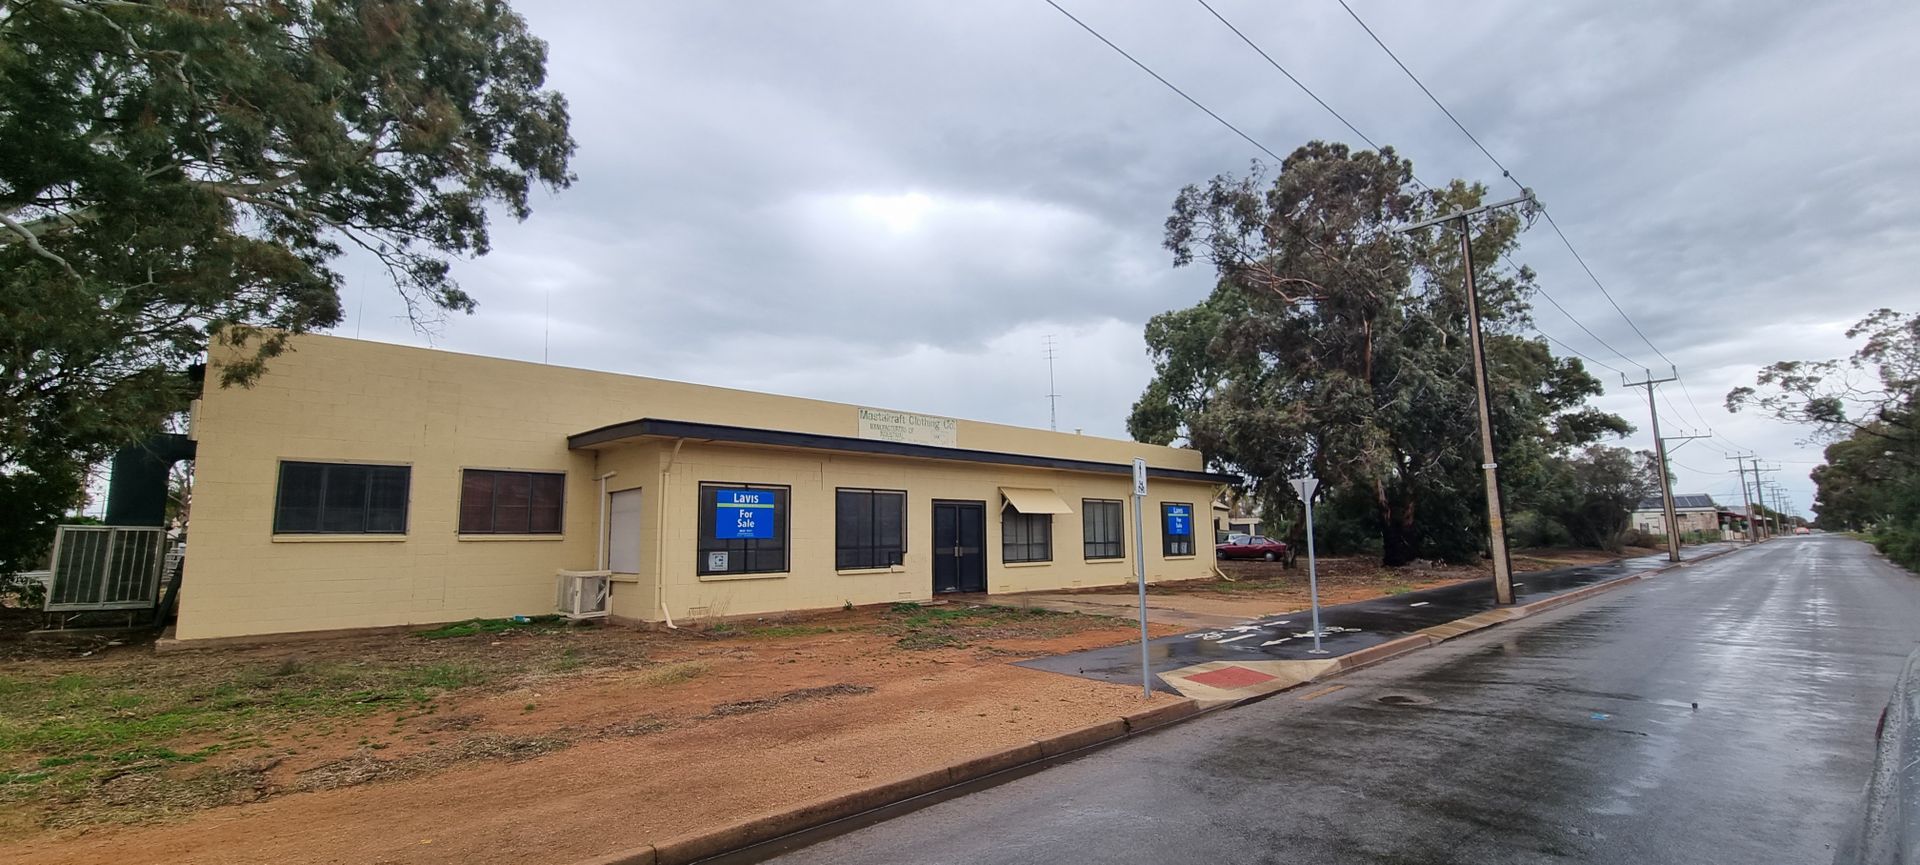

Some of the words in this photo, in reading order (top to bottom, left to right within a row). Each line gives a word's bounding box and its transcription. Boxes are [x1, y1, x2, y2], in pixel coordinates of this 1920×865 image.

[908, 415, 940, 430] Clothing
[733, 492, 759, 504] Lavis
[739, 509, 753, 519] For
[737, 518, 755, 528] Sale
